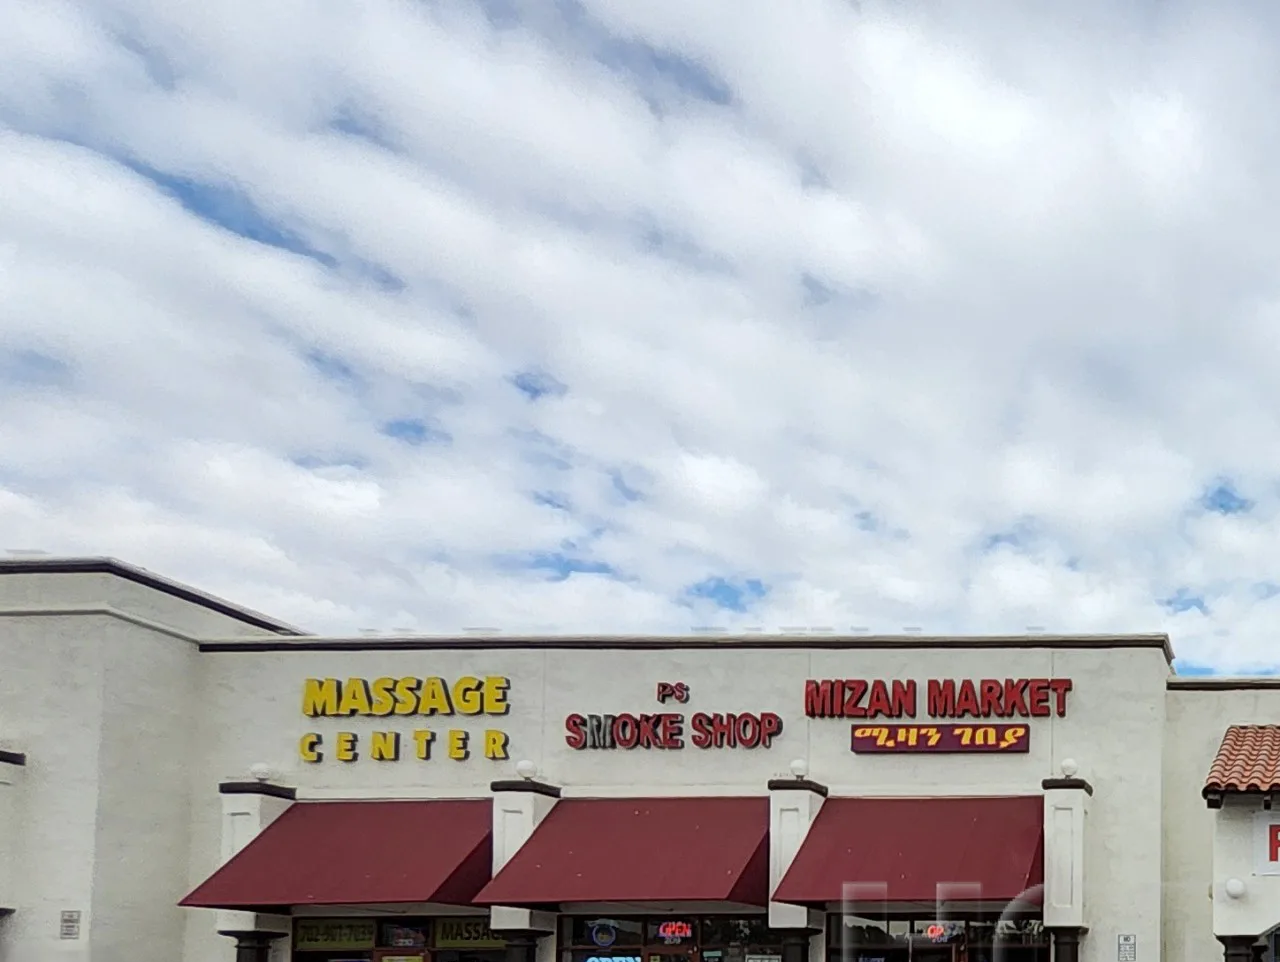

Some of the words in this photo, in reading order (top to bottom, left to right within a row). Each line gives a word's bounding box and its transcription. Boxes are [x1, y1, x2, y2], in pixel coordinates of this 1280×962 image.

[303, 677, 510, 718] MASSAGE
[805, 679, 916, 719] MIZAN
[927, 679, 1072, 719] MARKET
[300, 729, 510, 762] CENTER
[565, 713, 686, 749] SMOKE
[692, 712, 784, 749] SHOP
